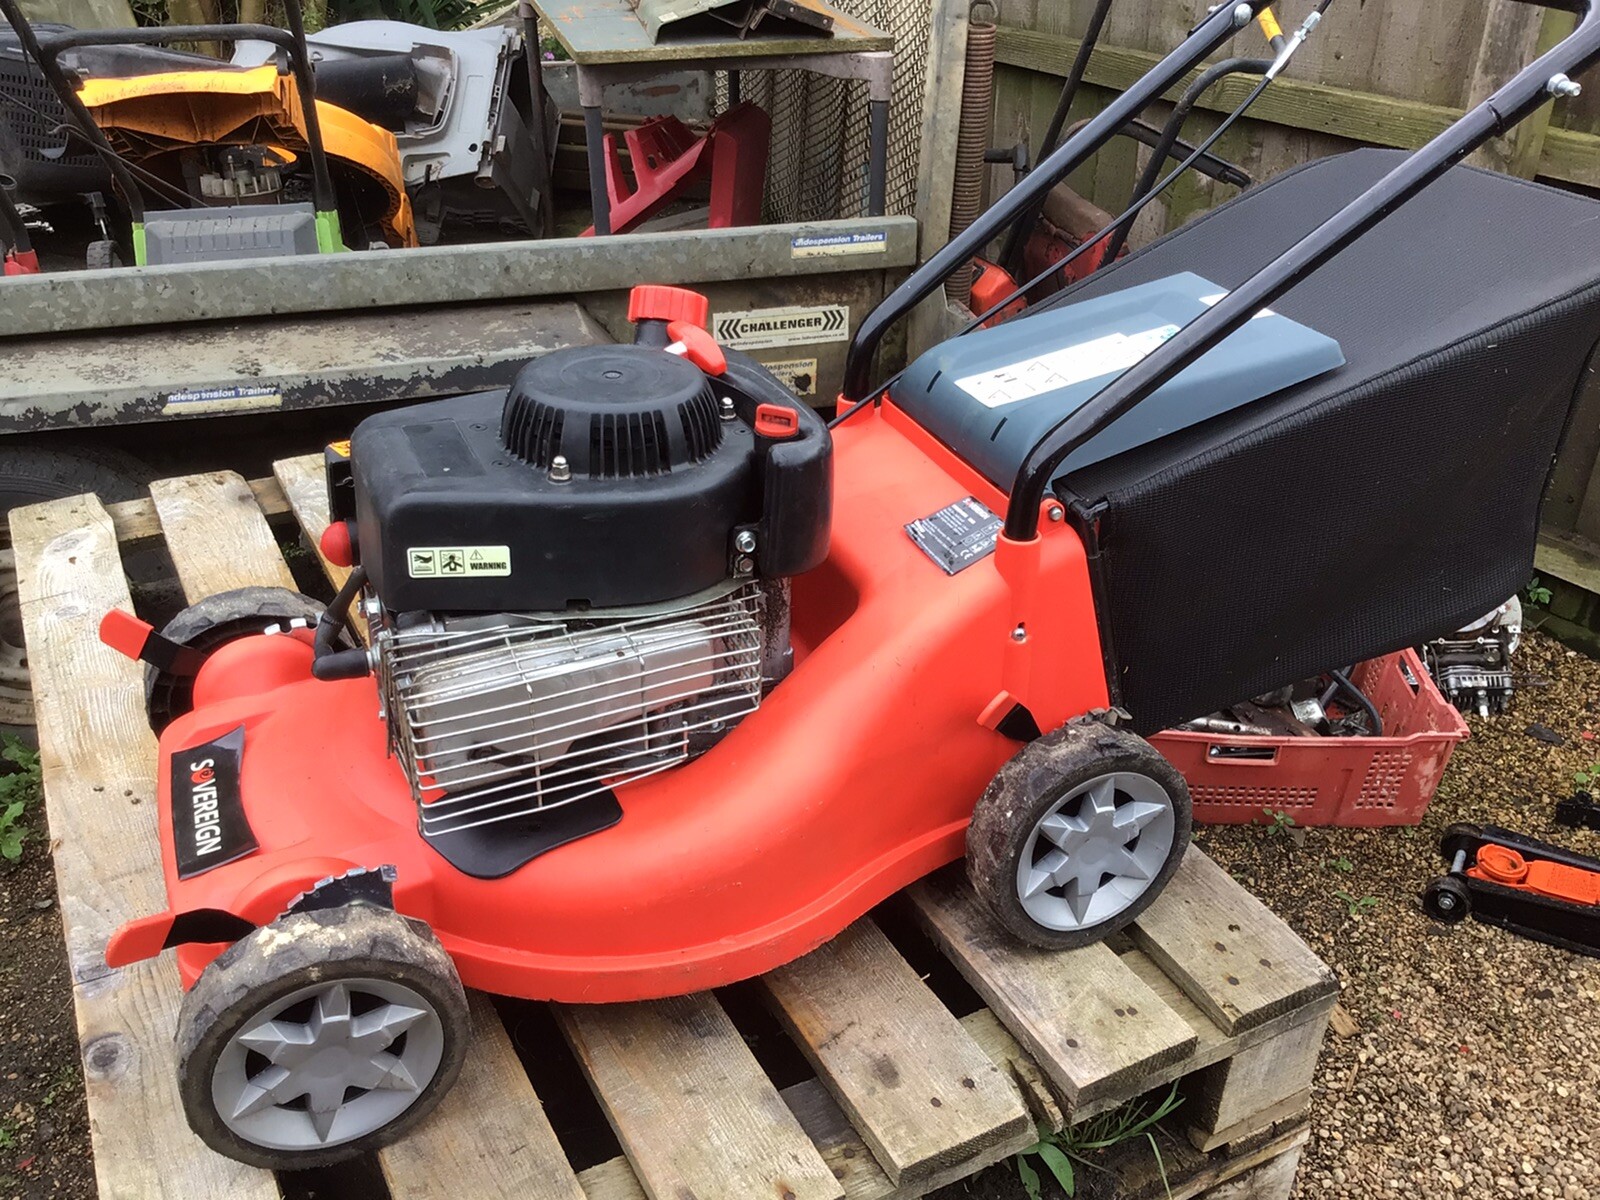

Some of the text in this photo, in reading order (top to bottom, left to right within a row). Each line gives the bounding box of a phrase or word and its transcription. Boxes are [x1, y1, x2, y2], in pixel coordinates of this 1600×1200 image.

[853, 232, 883, 242] Trailers
[740, 317, 822, 333] CHALLENGER
[168, 389, 235, 402] ndespension
[470, 562, 507, 570] WARNING
[190, 758, 222, 857] SOVEREIGN
